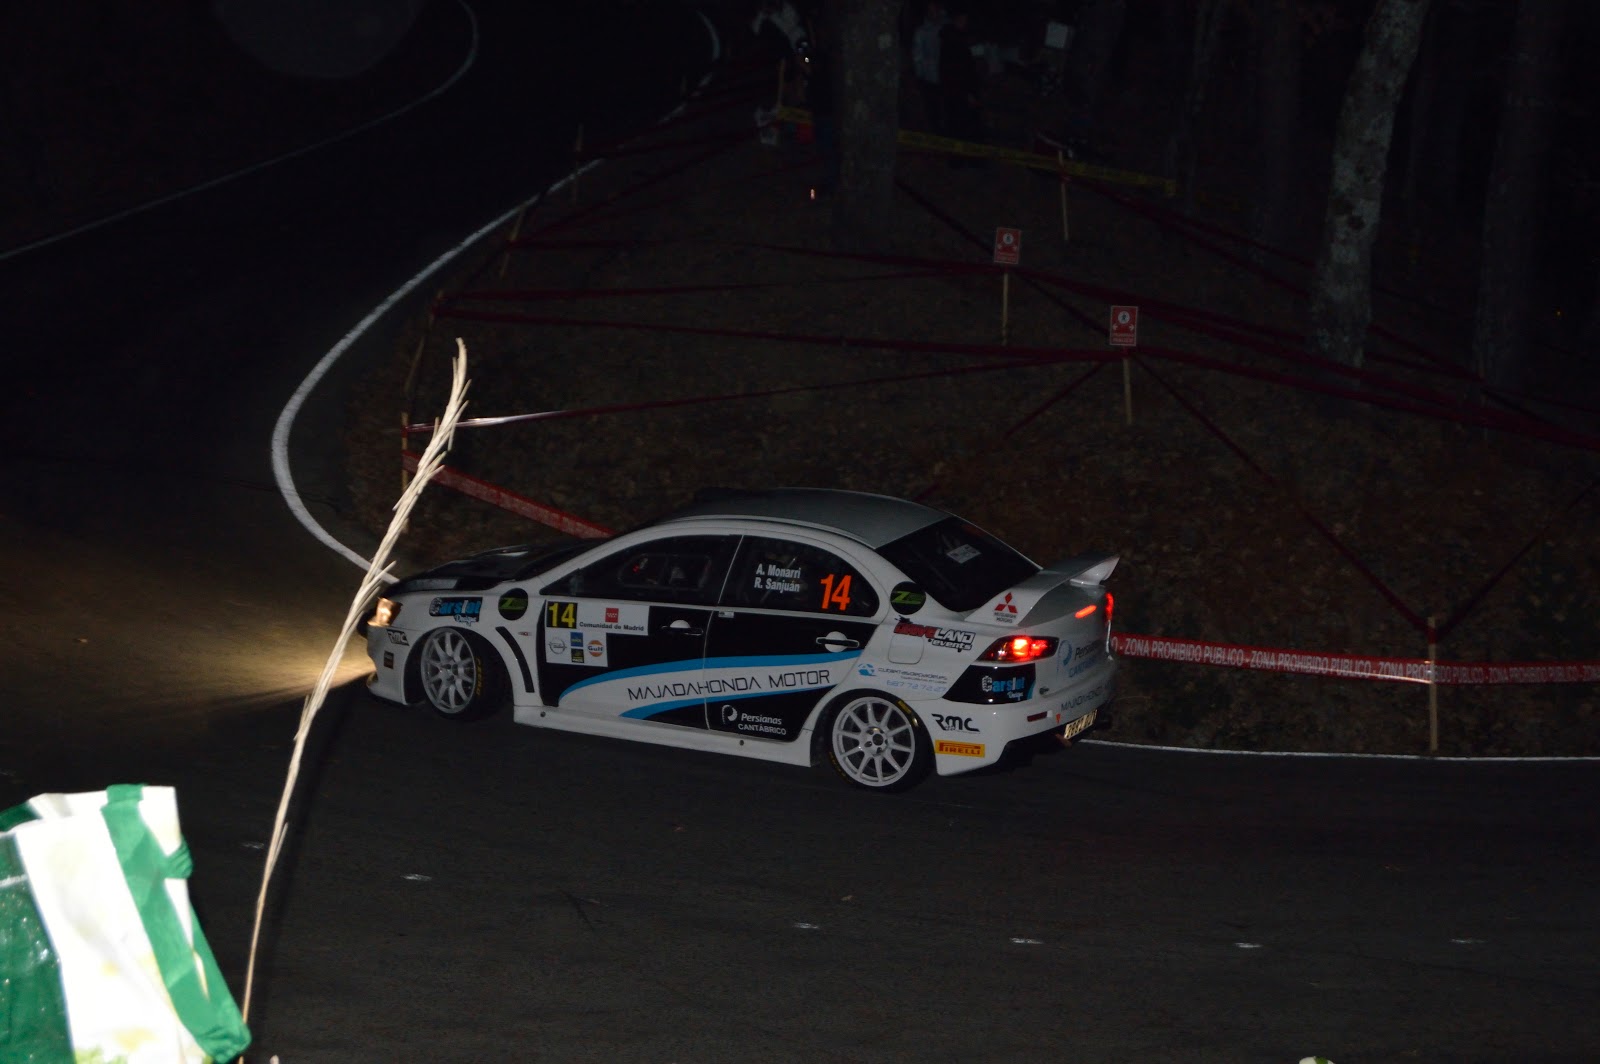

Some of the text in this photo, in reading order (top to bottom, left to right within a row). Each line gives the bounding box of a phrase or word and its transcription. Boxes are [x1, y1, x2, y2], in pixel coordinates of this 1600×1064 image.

[756, 563, 765, 575] A.
[754, 577, 800, 593] R. Sanjuán
[820, 573, 852, 611] 14
[549, 602, 576, 628] 14
[579, 621, 613, 630] Comunidad
[1124, 638, 1149, 657] ZONA
[1151, 640, 1201, 662] PROHIBIDO
[1250, 650, 1274, 669] ZONA
[1278, 653, 1329, 675] PROHIBIDO
[1378, 661, 1403, 680] ZONA
[627, 670, 830, 700] MAJADAHONDA MOTOR
[741, 713, 782, 725] Persianas
[939, 742, 981, 756] PIRELLI
